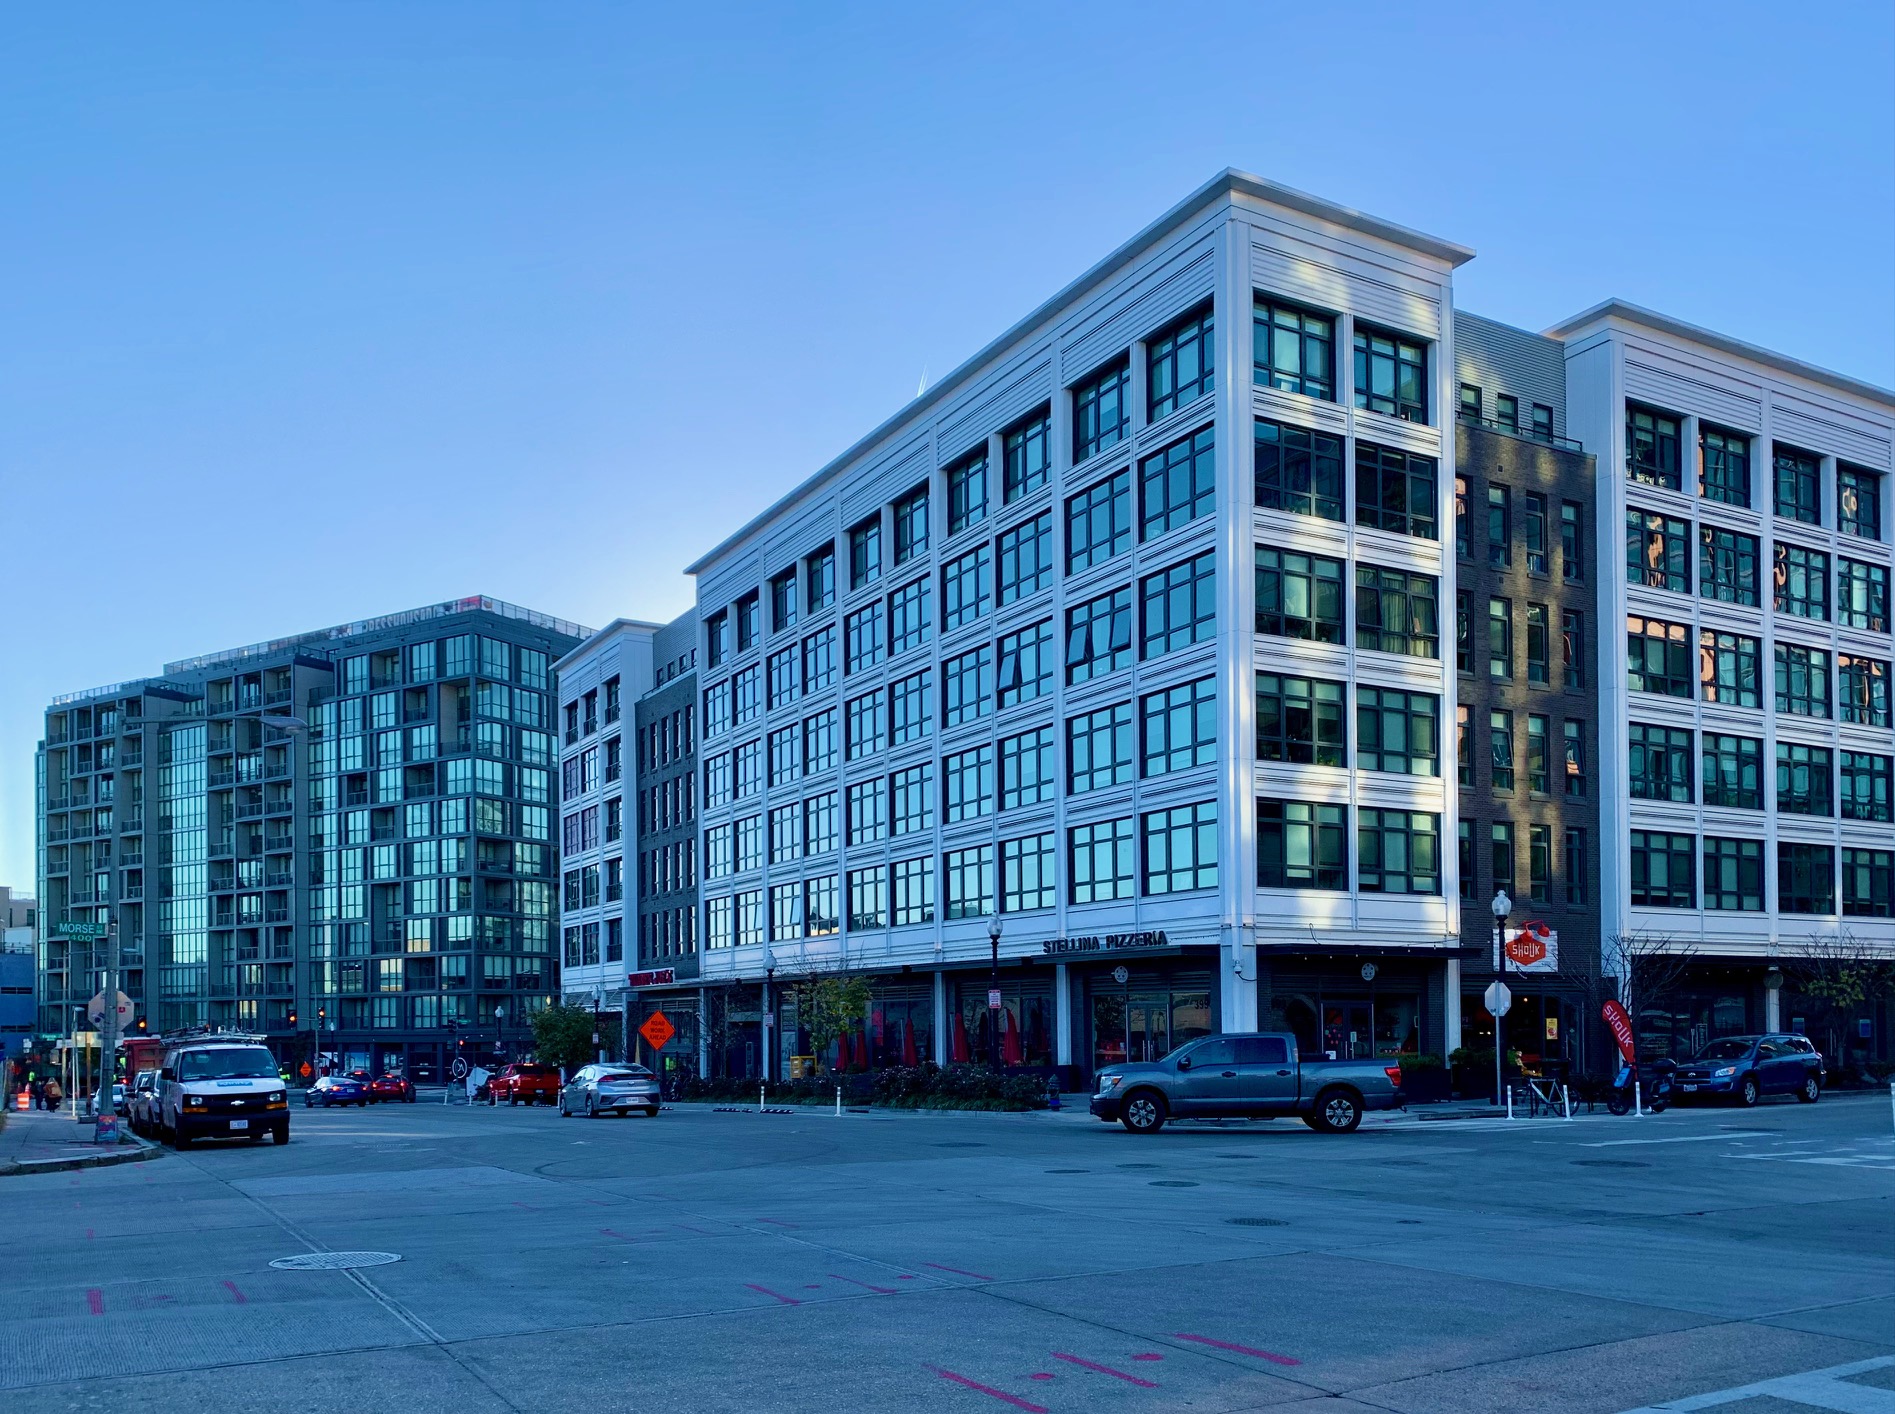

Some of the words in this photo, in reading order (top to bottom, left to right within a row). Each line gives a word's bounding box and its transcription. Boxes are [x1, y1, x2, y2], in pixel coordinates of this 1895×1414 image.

[59, 923, 95, 934] MORSE
[70, 934, 92, 942] 400
[1042, 936, 1101, 953] STELLINA
[1105, 930, 1168, 949] PIZZERIA
[1512, 943, 1540, 957] SHOUK
[1194, 999, 1209, 1009] 399
[1604, 1005, 1634, 1047] SHOUK
